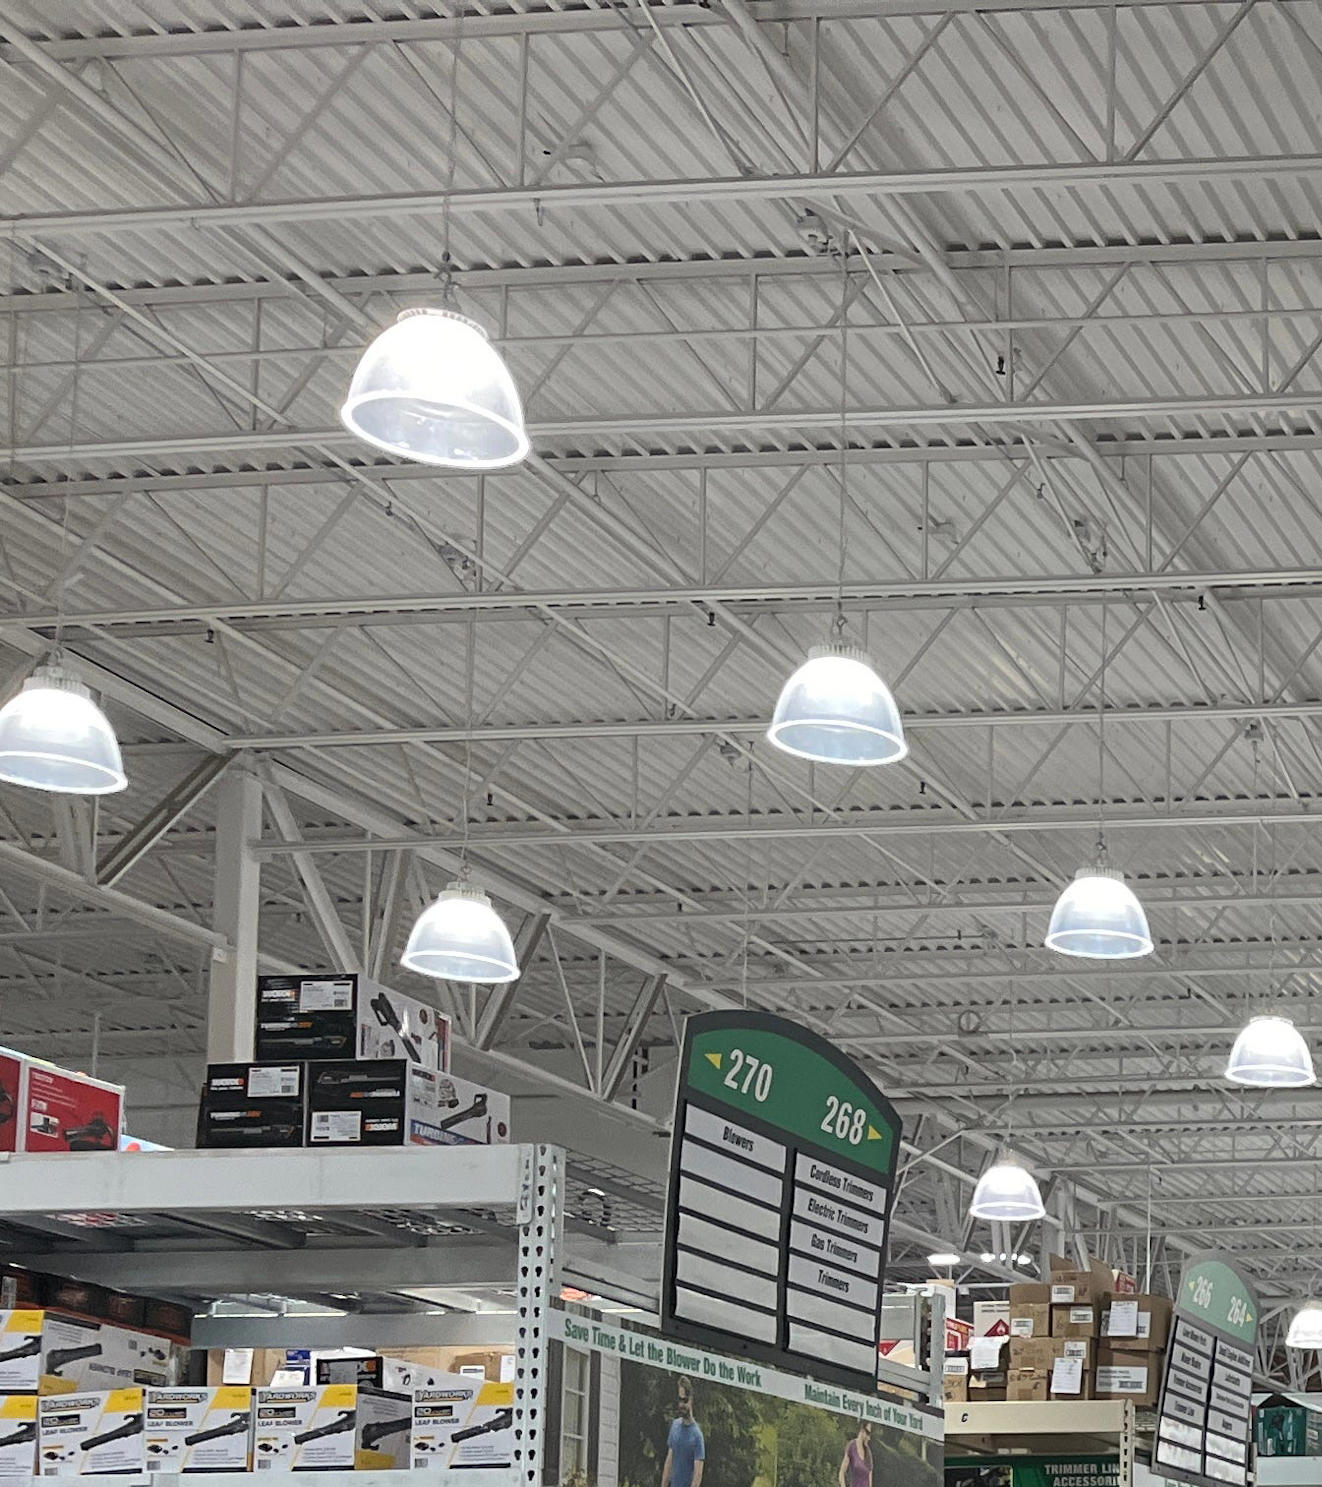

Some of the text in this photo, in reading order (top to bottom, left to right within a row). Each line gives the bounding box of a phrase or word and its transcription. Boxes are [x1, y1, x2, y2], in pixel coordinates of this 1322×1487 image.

[724, 1049, 773, 1102] 270
[820, 1095, 866, 1145] 268
[722, 1126, 754, 1152] Blowers
[810, 1164, 841, 1190] Cordless
[808, 1198, 836, 1223] Electric
[811, 1233, 827, 1252] Gas
[817, 1269, 849, 1294] Trimmers
[565, 1318, 762, 1388] Save Time & Let the Blower Do the Work
[805, 1383, 840, 1408] Maintain
[842, 1394, 864, 1417] Every
[1045, 1463, 1120, 1474] TRIMMER LIN
[1053, 1476, 1120, 1487] ACCESSORI
